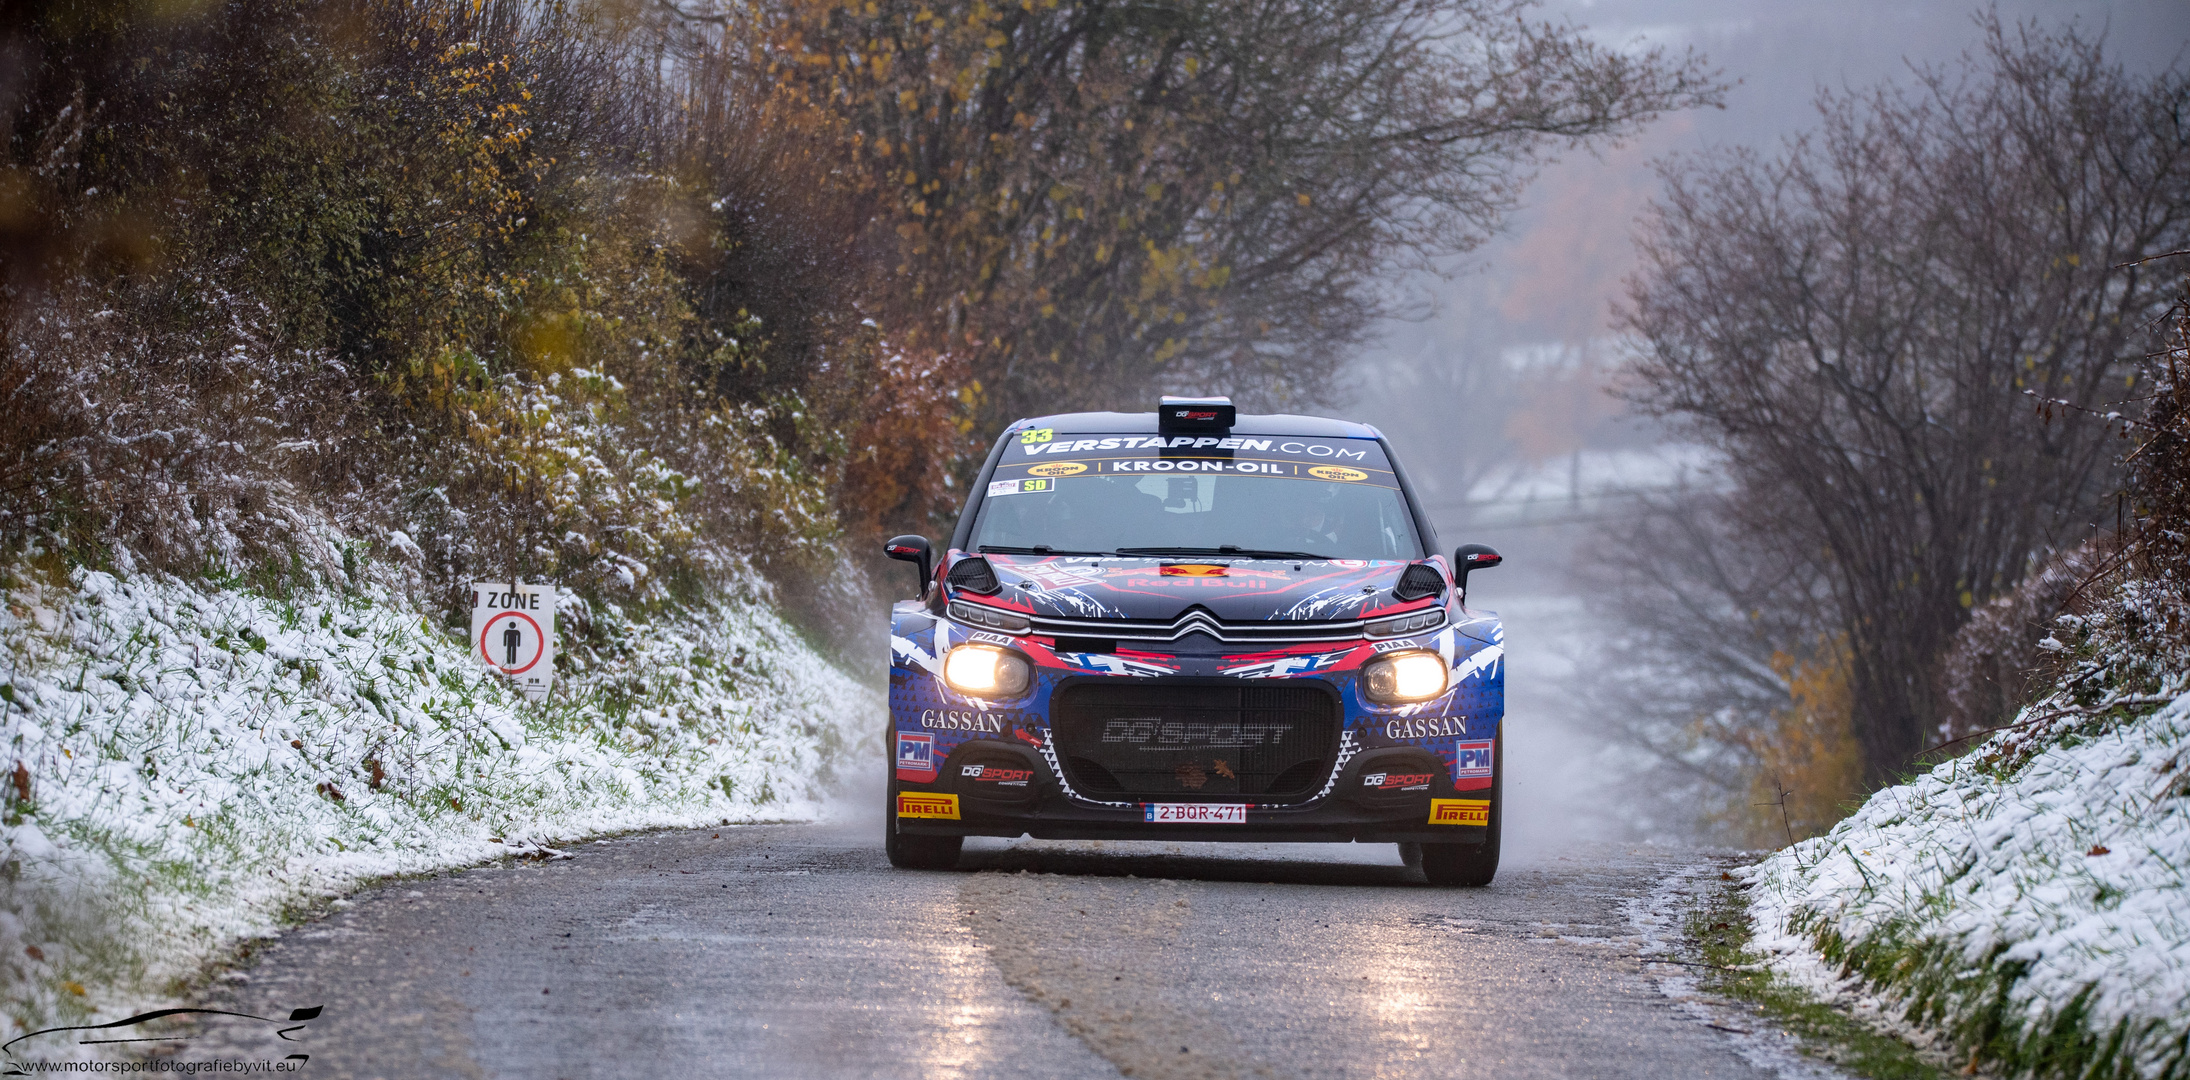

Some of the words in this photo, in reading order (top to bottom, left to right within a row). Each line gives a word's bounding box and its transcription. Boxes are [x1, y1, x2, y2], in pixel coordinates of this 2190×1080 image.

[1021, 428, 1053, 444] 33
[1024, 437, 1366, 461] VERSTAPPEN.COM
[1113, 461, 1283, 474] KROON-OIL
[1316, 470, 1359, 478] KROON
[1024, 480, 1046, 491] SD
[1127, 578, 1195, 587] Red
[1201, 578, 1267, 588] Bull
[487, 592, 540, 610] ZONE
[973, 632, 1010, 645] PIAA
[1374, 640, 1416, 651] PIAA
[921, 709, 1003, 733] GASSAN
[1386, 715, 1467, 739] GASSAN
[899, 740, 930, 760] PM
[1460, 749, 1490, 768] PM
[898, 797, 953, 815] PIRELLI
[1160, 806, 1242, 820] 2-BQR-471
[1436, 804, 1489, 820] PIRELLI
